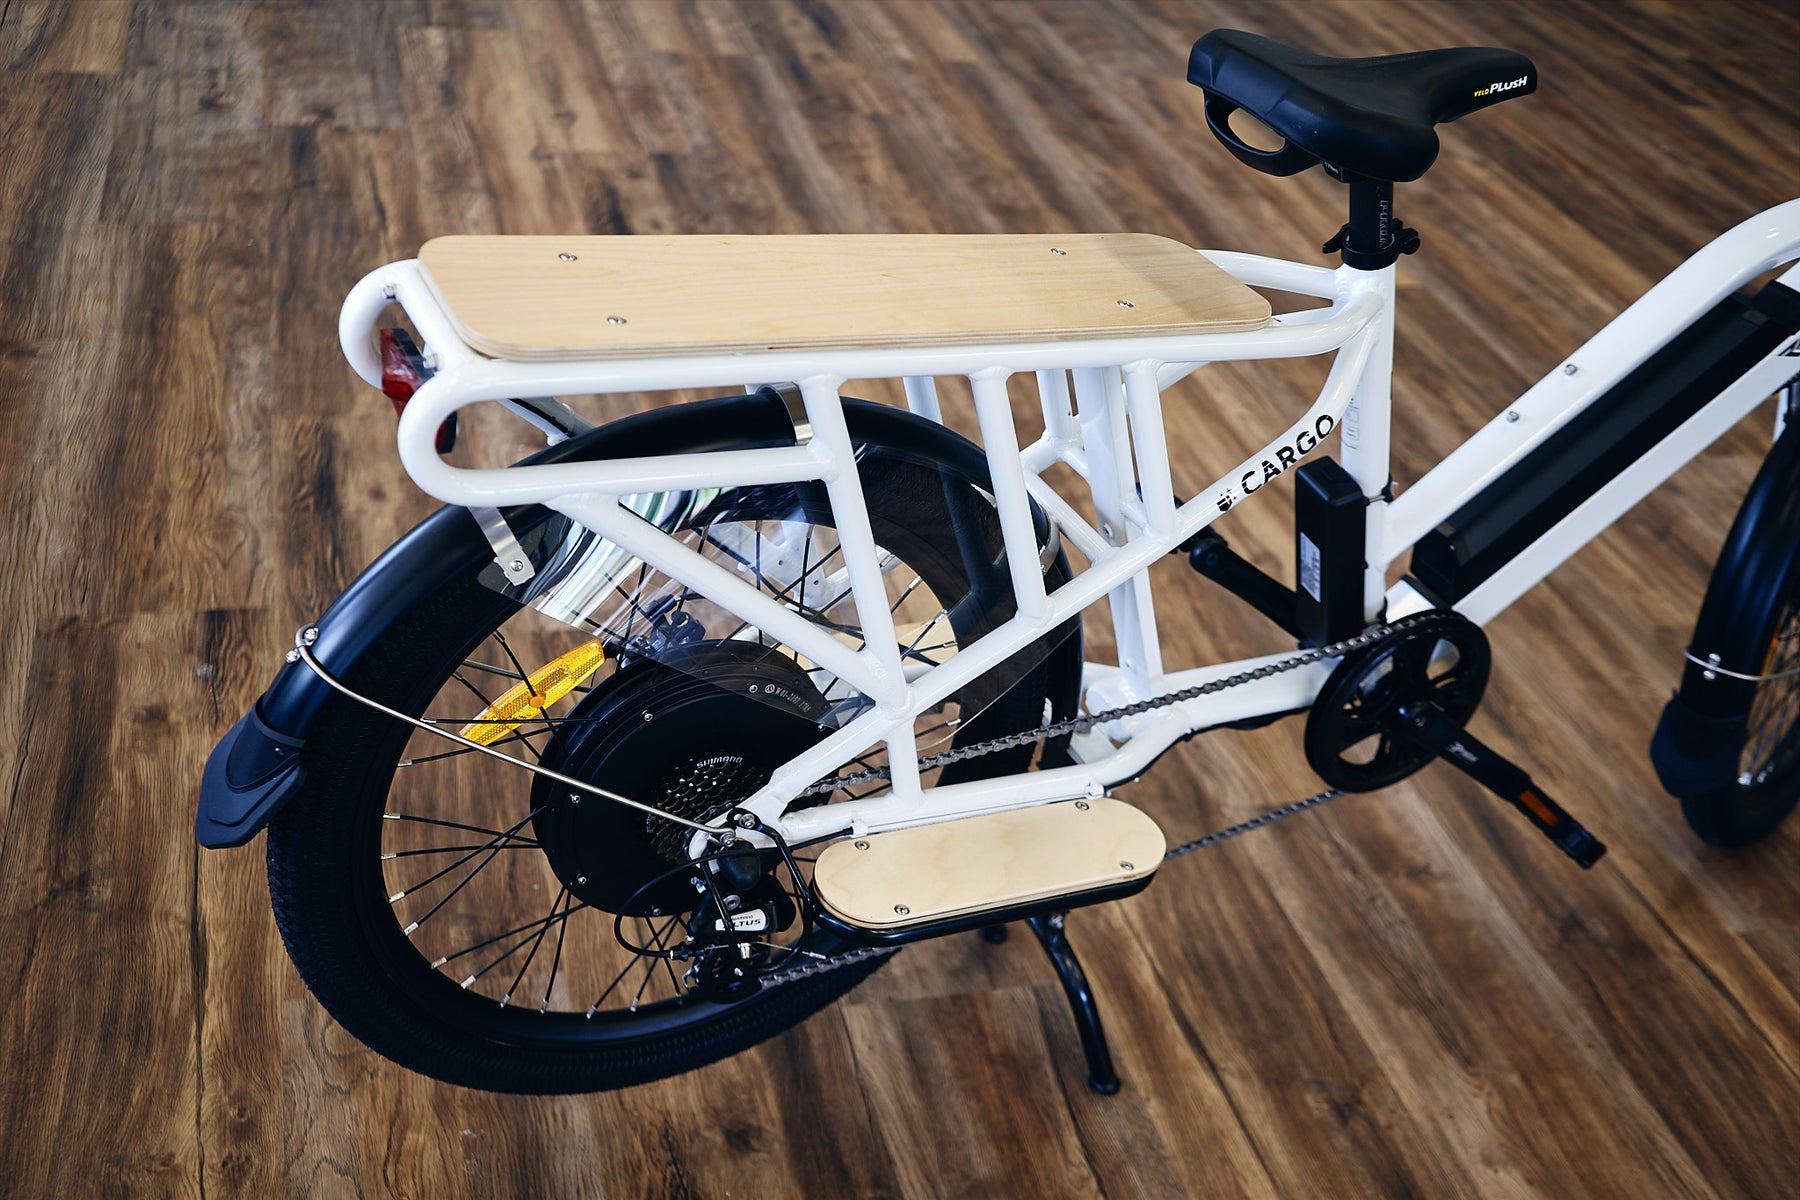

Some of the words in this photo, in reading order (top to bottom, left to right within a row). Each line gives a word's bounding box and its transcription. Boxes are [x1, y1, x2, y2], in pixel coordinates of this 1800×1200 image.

[1490, 75, 1528, 94] PLUSH
[1241, 414, 1334, 495] CARGO
[696, 756, 743, 769] SHIMANO
